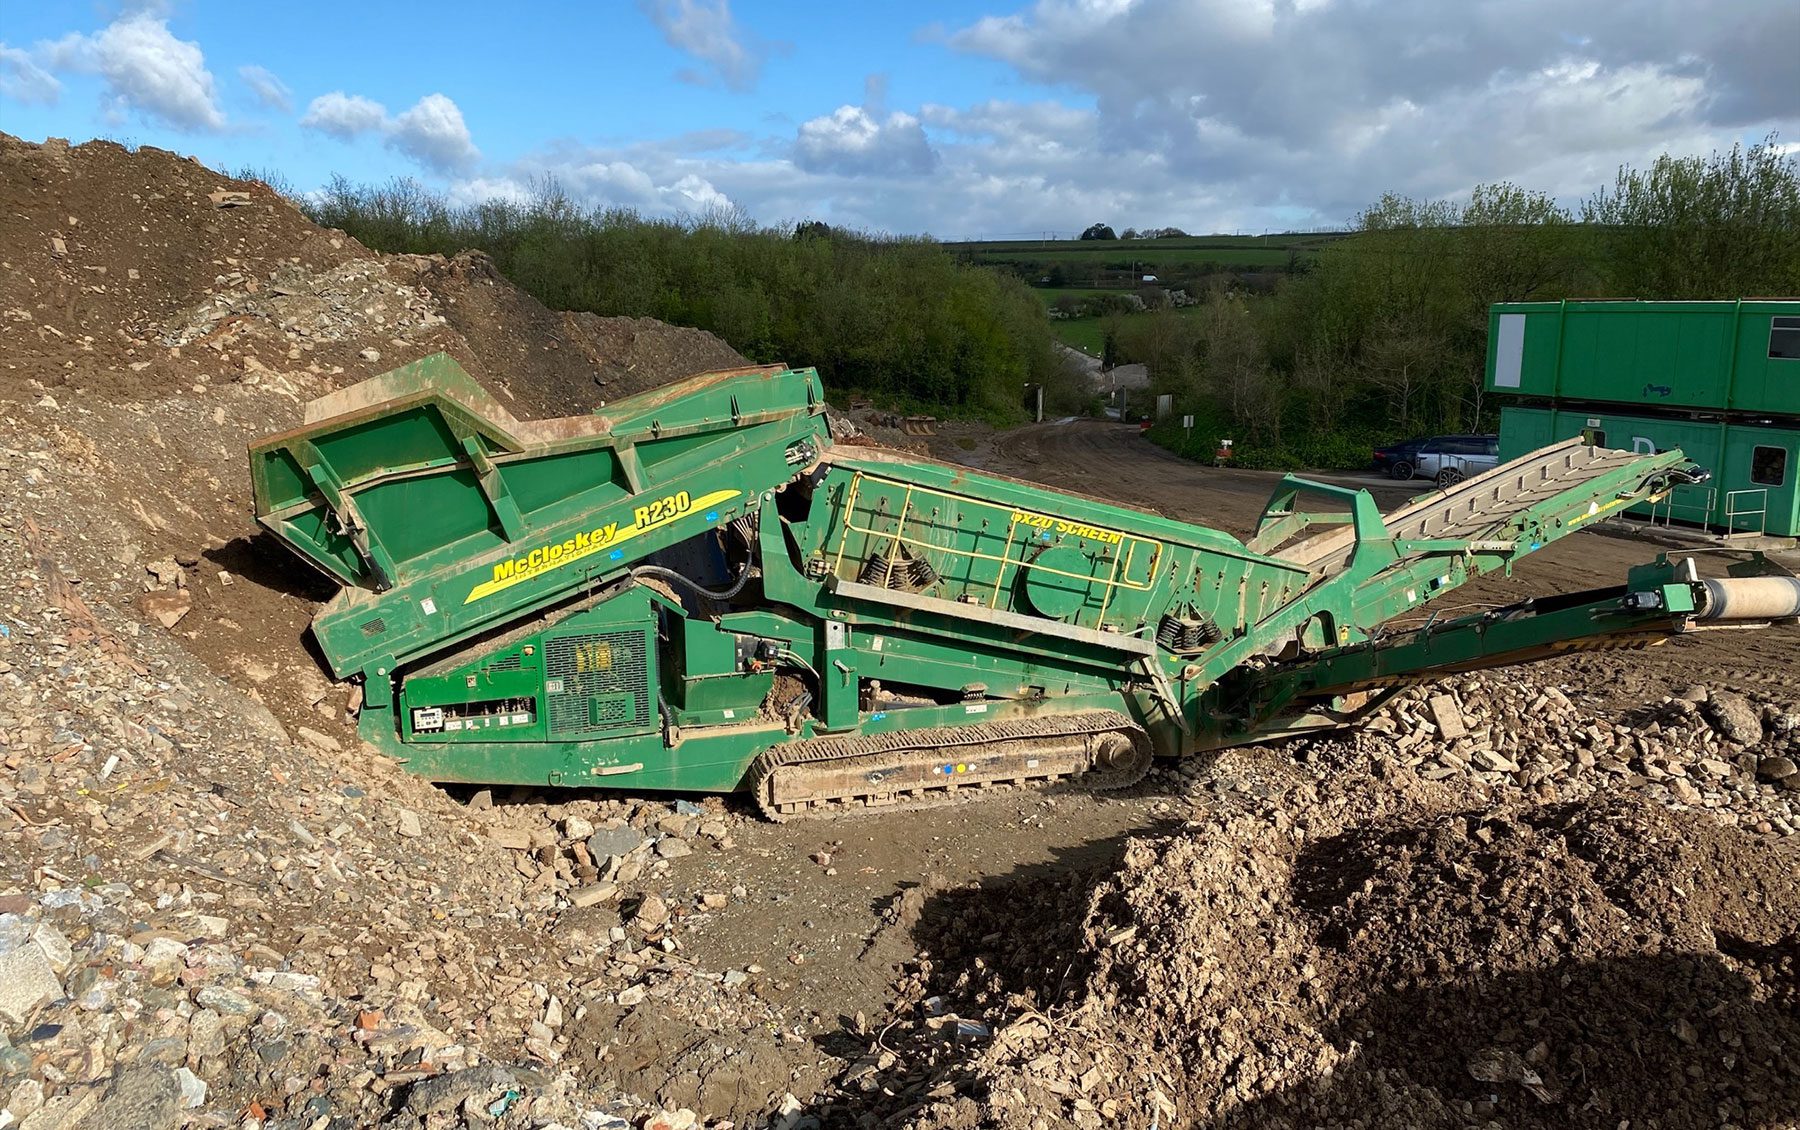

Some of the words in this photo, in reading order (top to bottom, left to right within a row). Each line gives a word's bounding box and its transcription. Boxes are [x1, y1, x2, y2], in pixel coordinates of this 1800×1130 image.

[493, 522, 619, 583] McCloskey
[635, 491, 691, 530] R230
[1056, 521, 1121, 544] SCREEN
